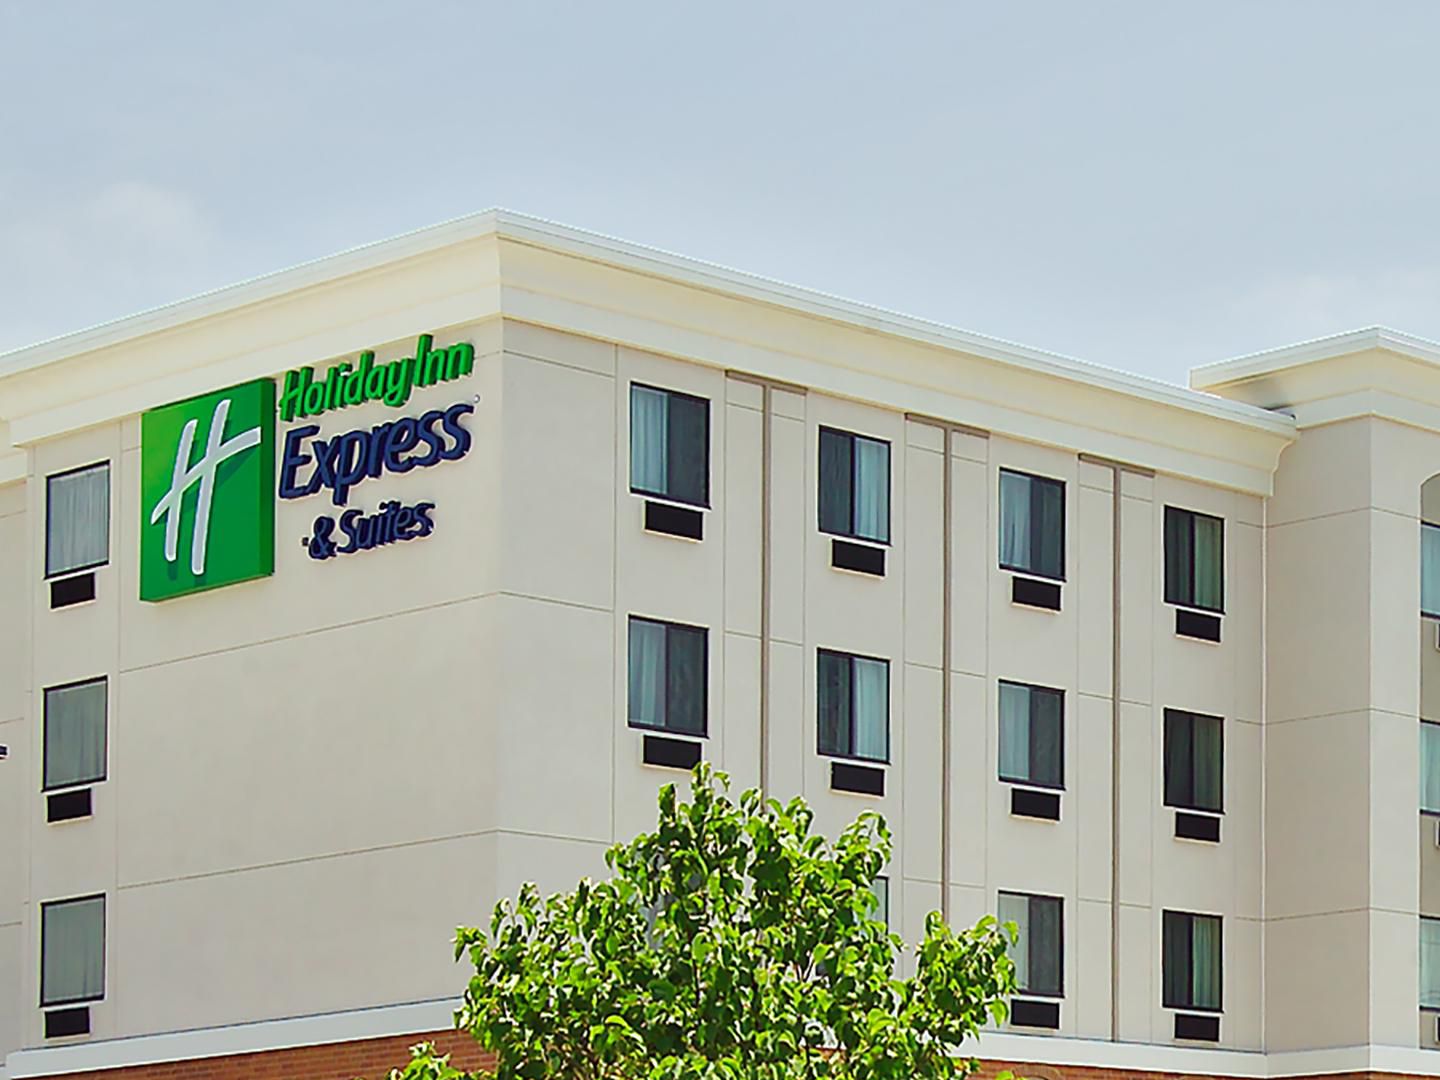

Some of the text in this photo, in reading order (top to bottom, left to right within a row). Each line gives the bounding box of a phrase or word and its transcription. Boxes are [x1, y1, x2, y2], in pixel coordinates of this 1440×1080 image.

[279, 334, 475, 422] Holiday Inn
[278, 403, 476, 507] Express
[308, 501, 436, 560] & Suites
